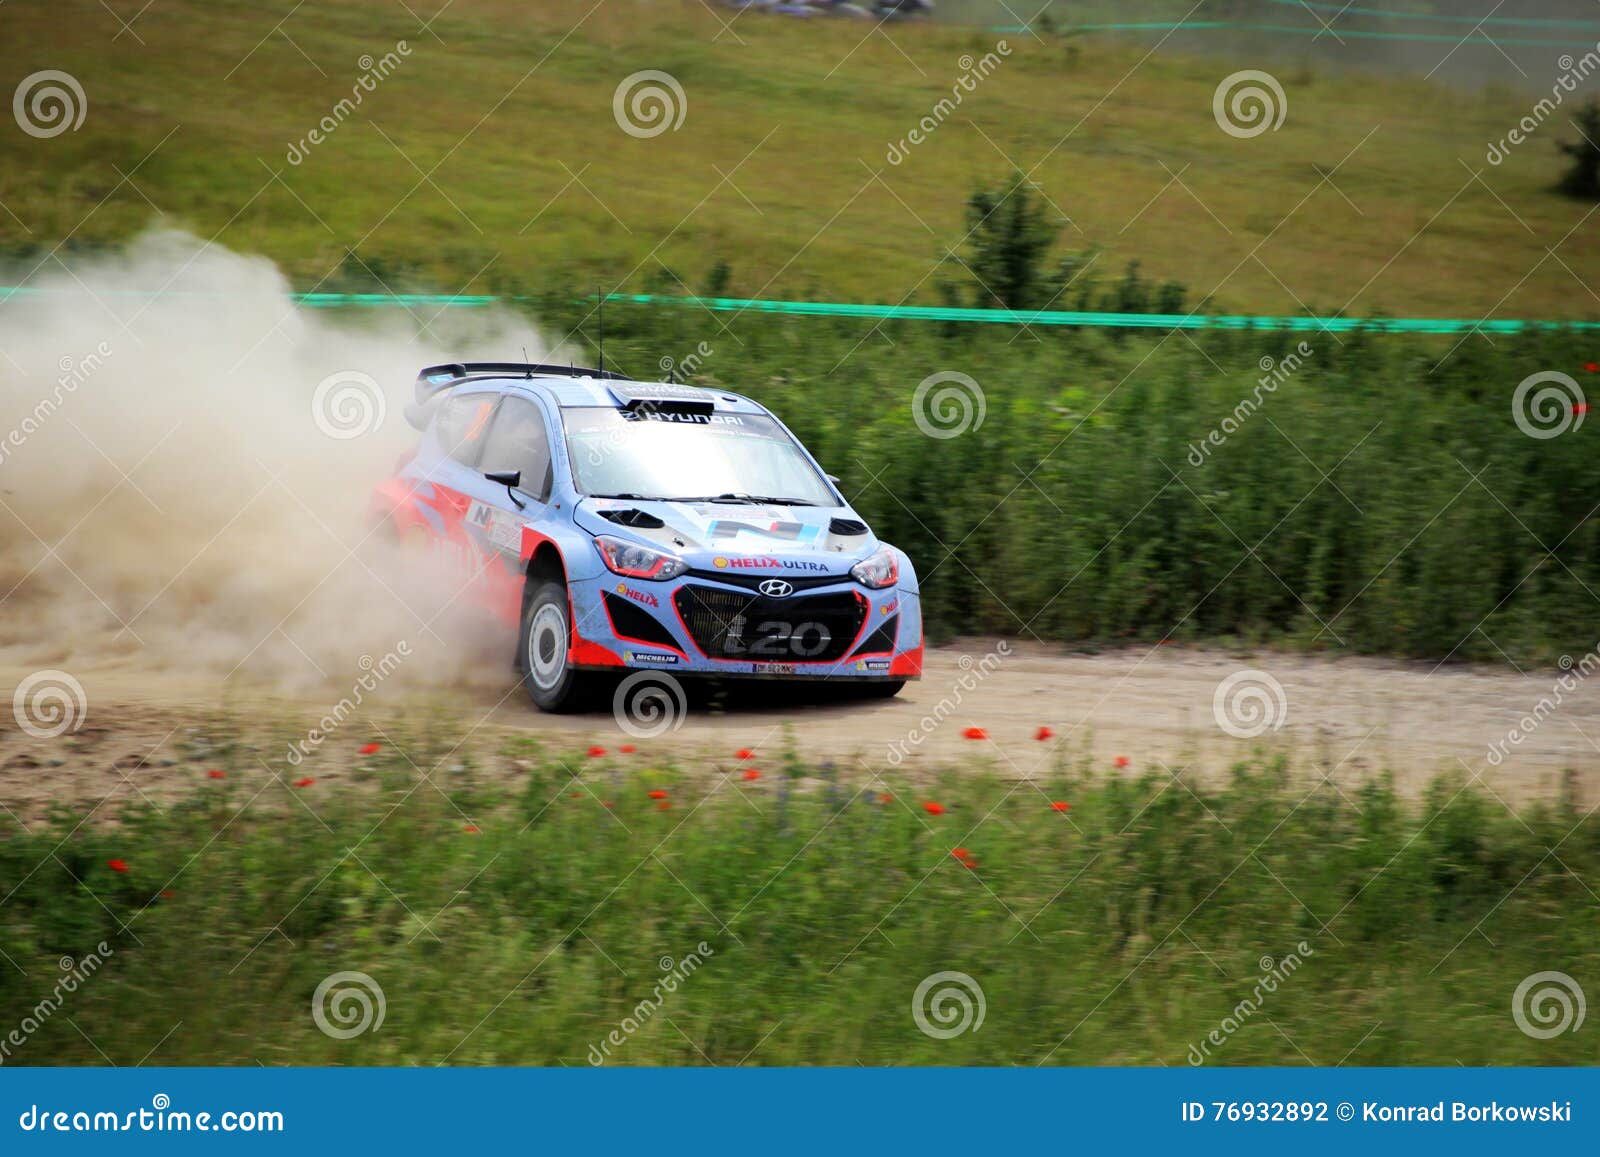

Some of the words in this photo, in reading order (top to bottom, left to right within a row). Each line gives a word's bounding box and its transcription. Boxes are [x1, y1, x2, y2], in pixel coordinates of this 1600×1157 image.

[730, 556, 783, 569] HELIX
[782, 560, 829, 573] ULTRA
[626, 588, 659, 608] HELIX
[636, 653, 676, 663] MICHELIN
